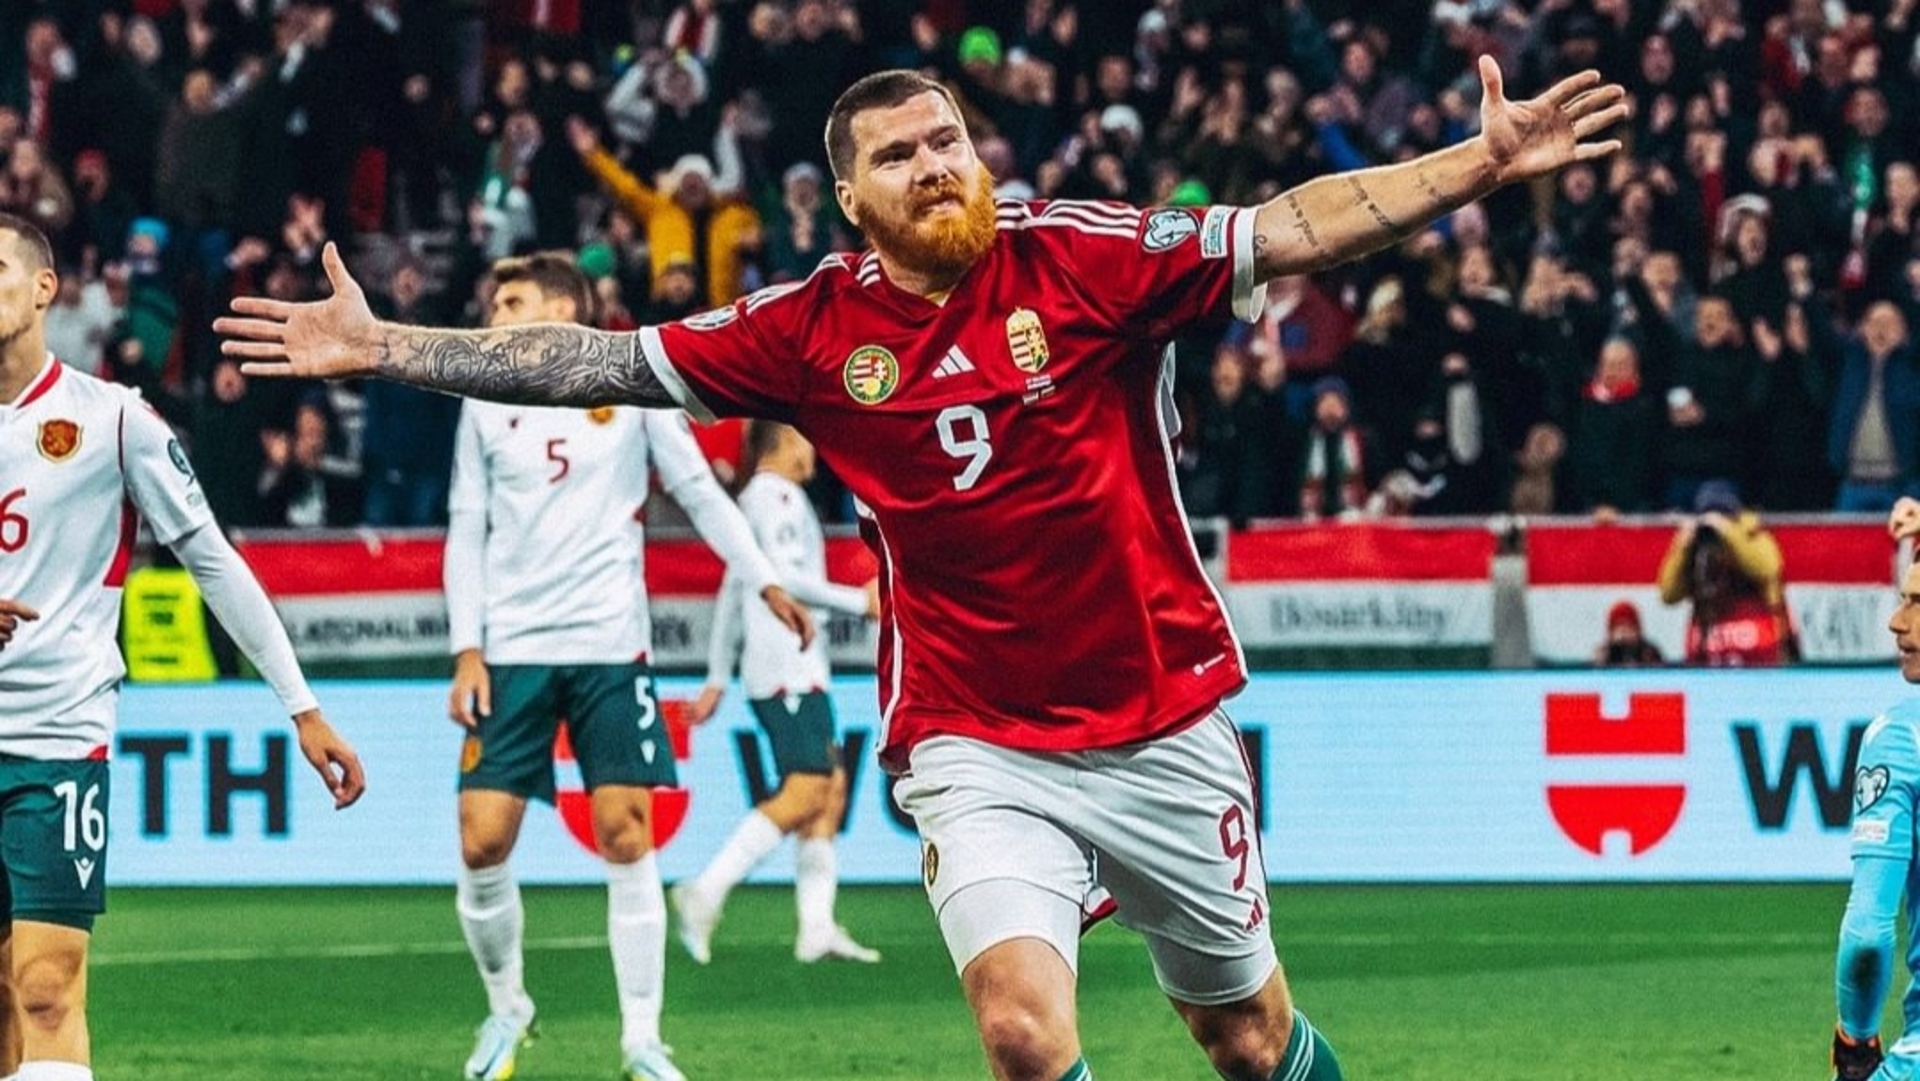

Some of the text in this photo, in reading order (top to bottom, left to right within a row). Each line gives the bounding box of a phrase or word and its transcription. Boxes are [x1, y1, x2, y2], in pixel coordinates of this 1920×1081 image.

[546, 438, 570, 483] 5
[935, 405, 993, 491] 9
[634, 675, 657, 730] 5
[53, 780, 105, 852] 16
[116, 734, 288, 835] TH
[1219, 803, 1249, 892] 9
